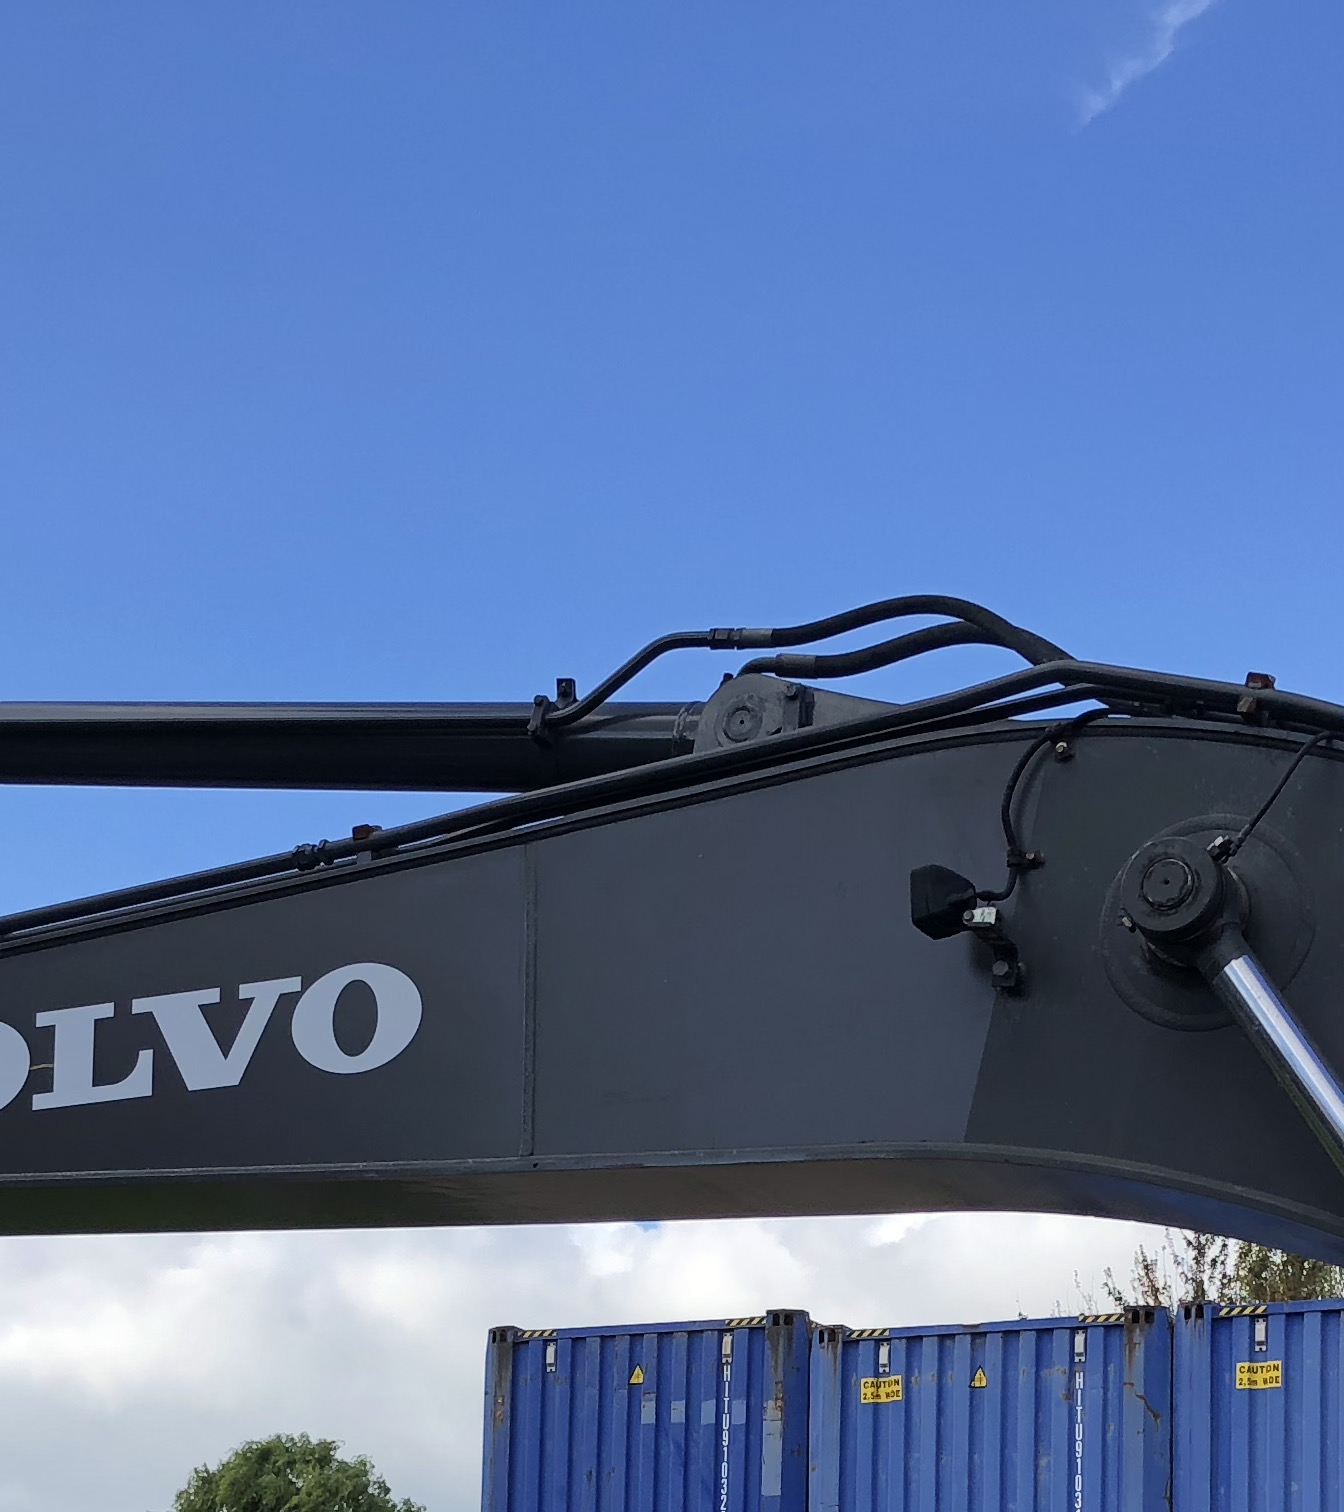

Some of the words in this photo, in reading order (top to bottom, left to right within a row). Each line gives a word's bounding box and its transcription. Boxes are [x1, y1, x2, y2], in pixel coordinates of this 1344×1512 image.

[1239, 1363, 1280, 1374] CAUTON
[863, 1378, 900, 1389] CAUTON
[1262, 1376, 1280, 1385] WDE
[885, 1390, 901, 1399] WDE
